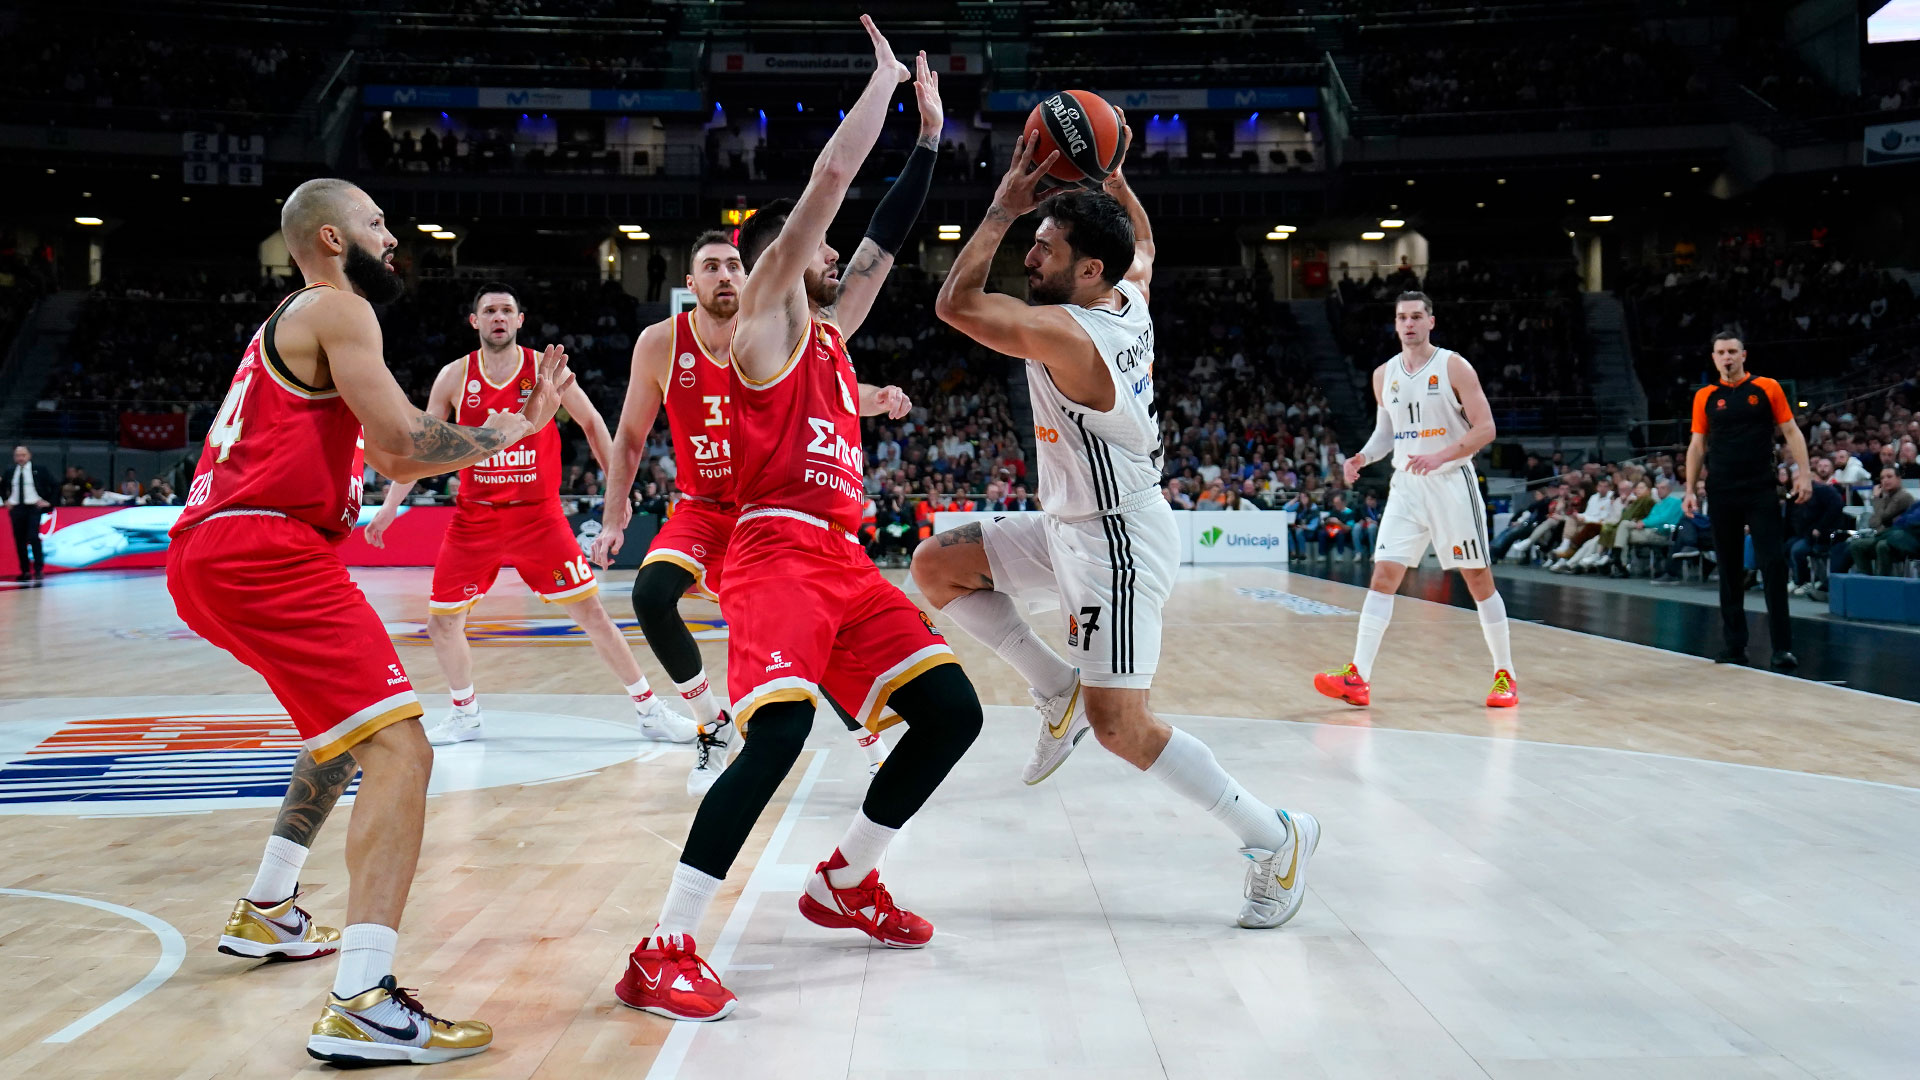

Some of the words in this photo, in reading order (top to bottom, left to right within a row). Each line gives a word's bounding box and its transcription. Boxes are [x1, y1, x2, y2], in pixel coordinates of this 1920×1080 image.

[766, 56, 849, 69] Comunidad
[854, 57, 872, 69] de
[1045, 95, 1088, 157] SPALDING
[208, 369, 255, 464] 4
[1407, 401, 1421, 425] 11
[1394, 427, 1447, 440] AUTOHERO
[473, 472, 538, 485] FOUNDATION
[1226, 533, 1280, 550] Unicaja
[1463, 539, 1479, 560] 11
[564, 554, 593, 585] 16
[1080, 606, 1101, 651] 7
